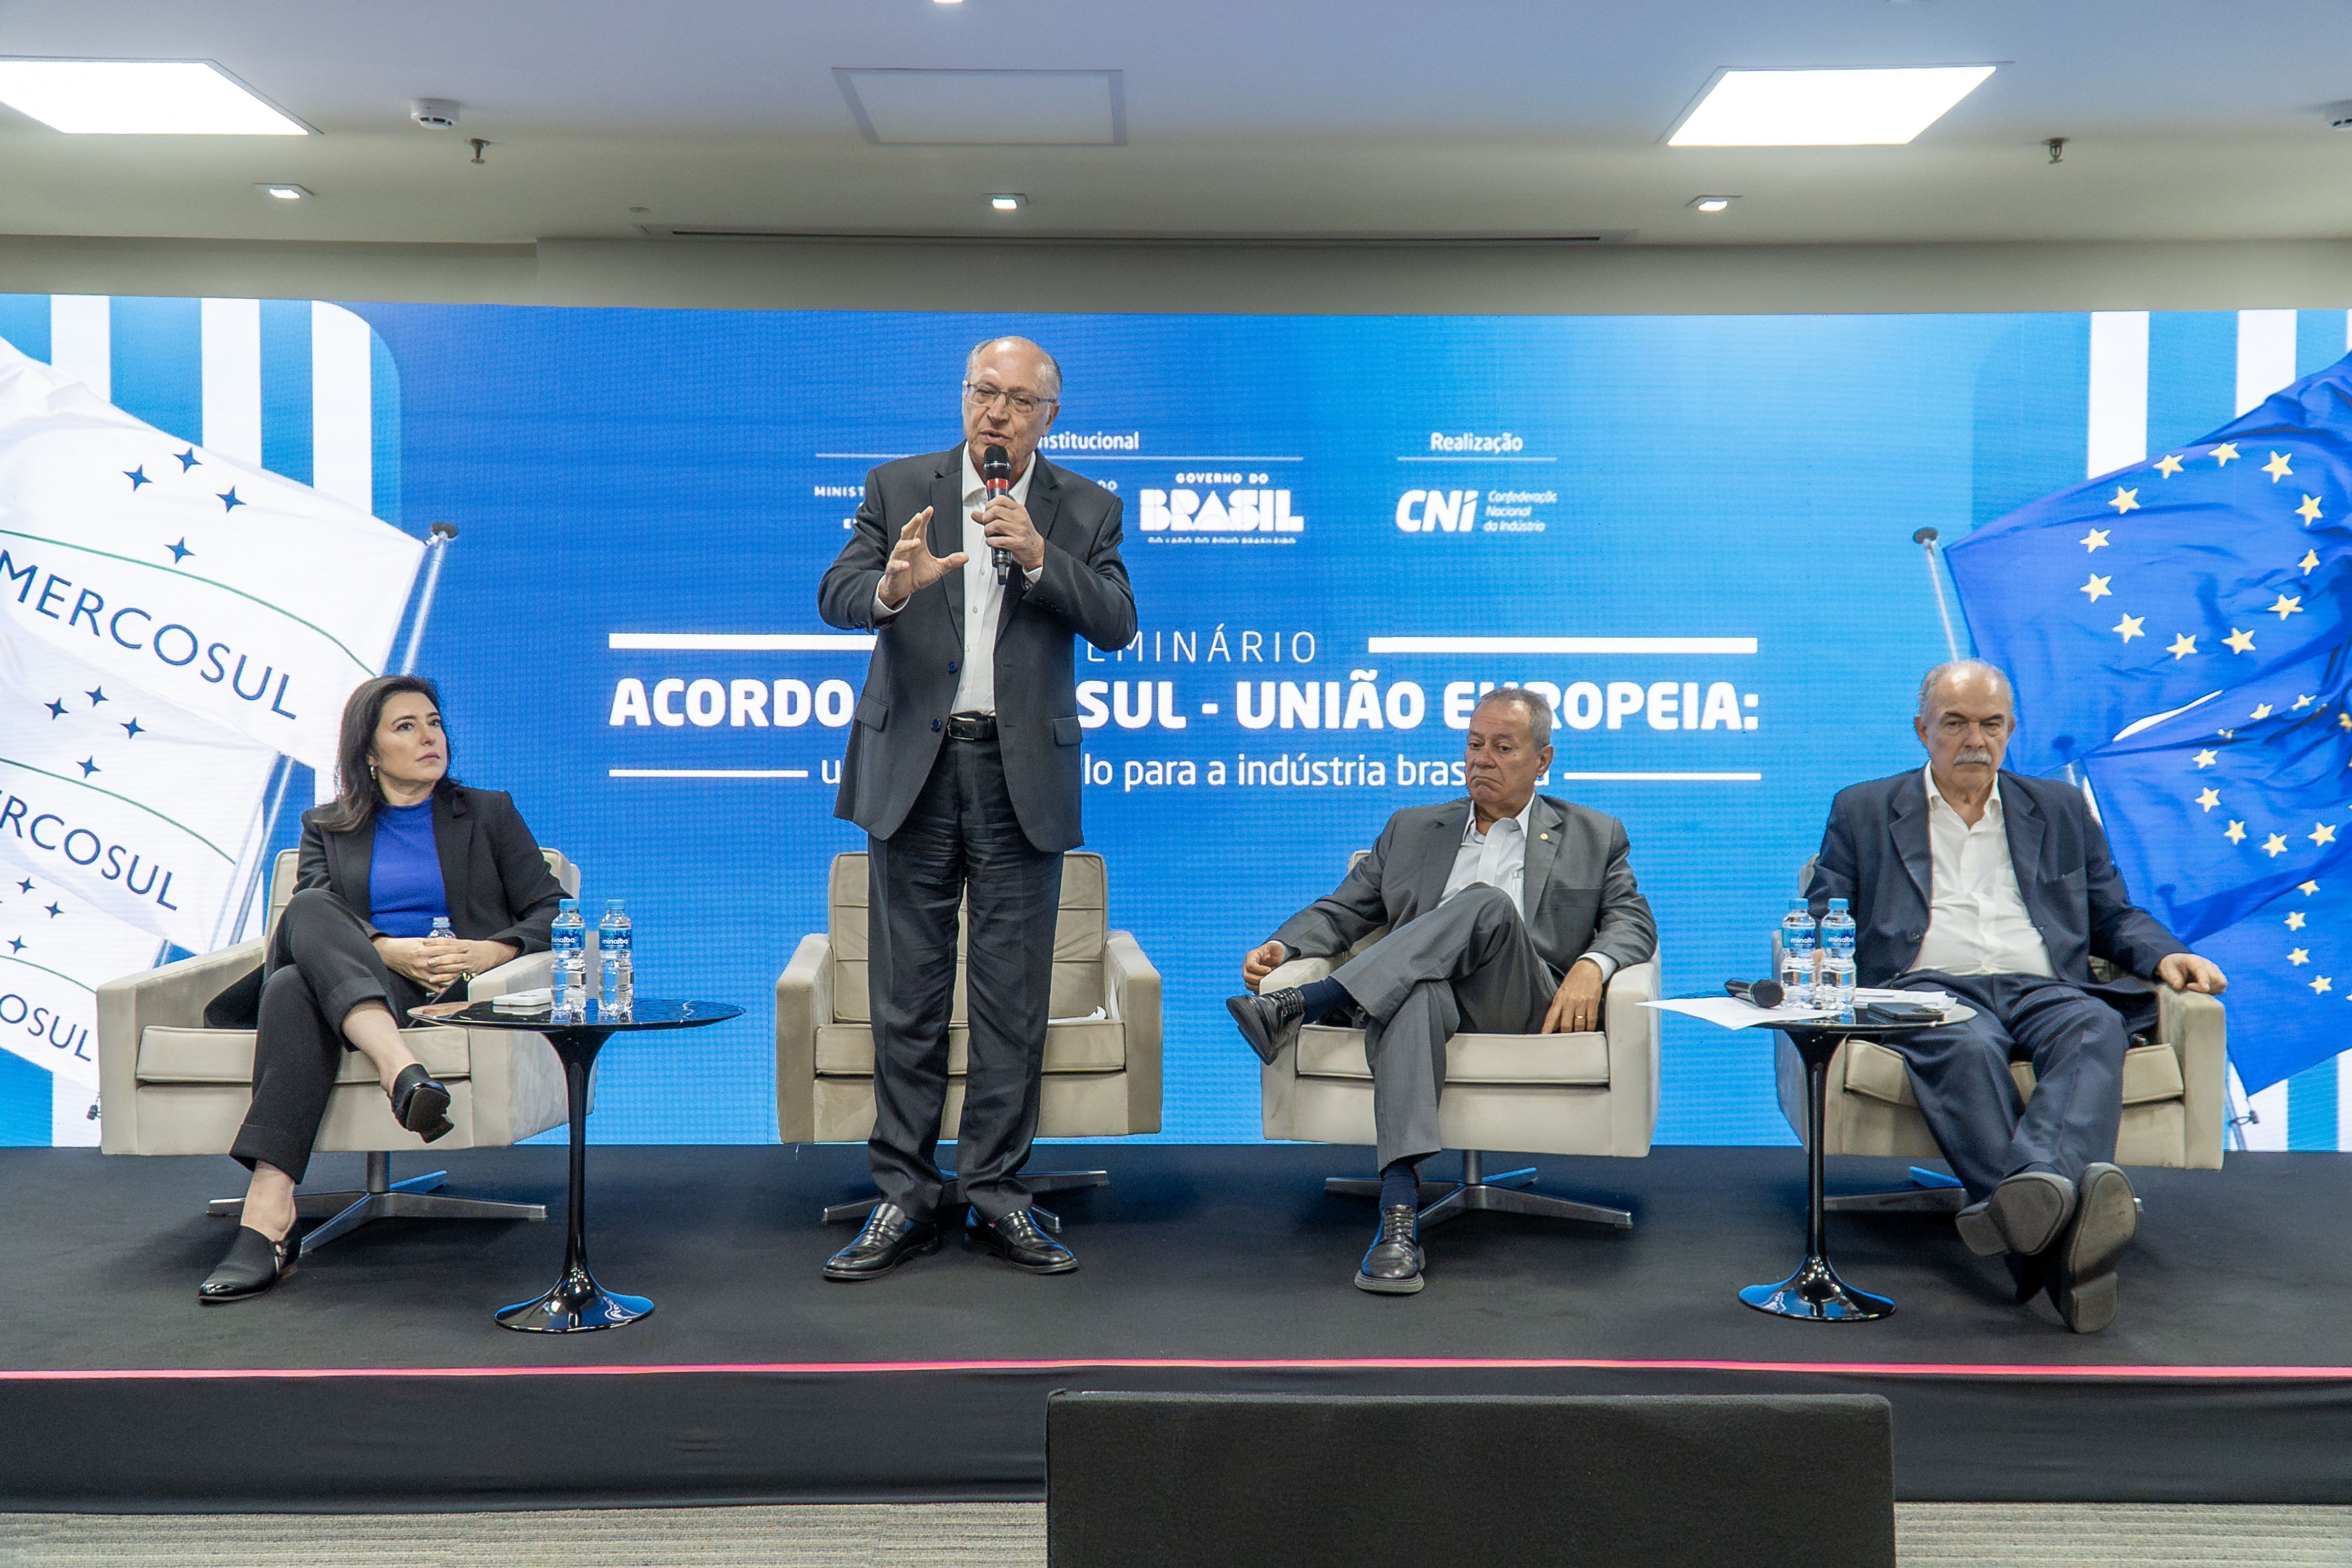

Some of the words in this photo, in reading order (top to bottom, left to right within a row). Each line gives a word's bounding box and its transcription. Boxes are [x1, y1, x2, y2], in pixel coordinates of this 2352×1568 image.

[1037, 430, 1139, 450] nstitucional
[1431, 432, 1523, 452] Realização
[814, 486, 865, 498] MINIST
[1175, 473, 1242, 484] GOVERNO
[1248, 473, 1269, 484] DO
[1140, 489, 1304, 532] BRASIL
[1485, 505, 1532, 518] Nacional
[0, 549, 296, 720] MERCOSUL
[1087, 624, 1315, 663] EMINÁRIO
[609, 678, 854, 727] ACORDO
[1236, 669, 1425, 729] UNIÃO
[1444, 681, 1759, 730] EROPEIA:
[1125, 761, 1196, 792] para
[1208, 761, 1226, 786] a
[1238, 753, 1385, 786] indústria
[0, 790, 178, 911] RCOSUL
